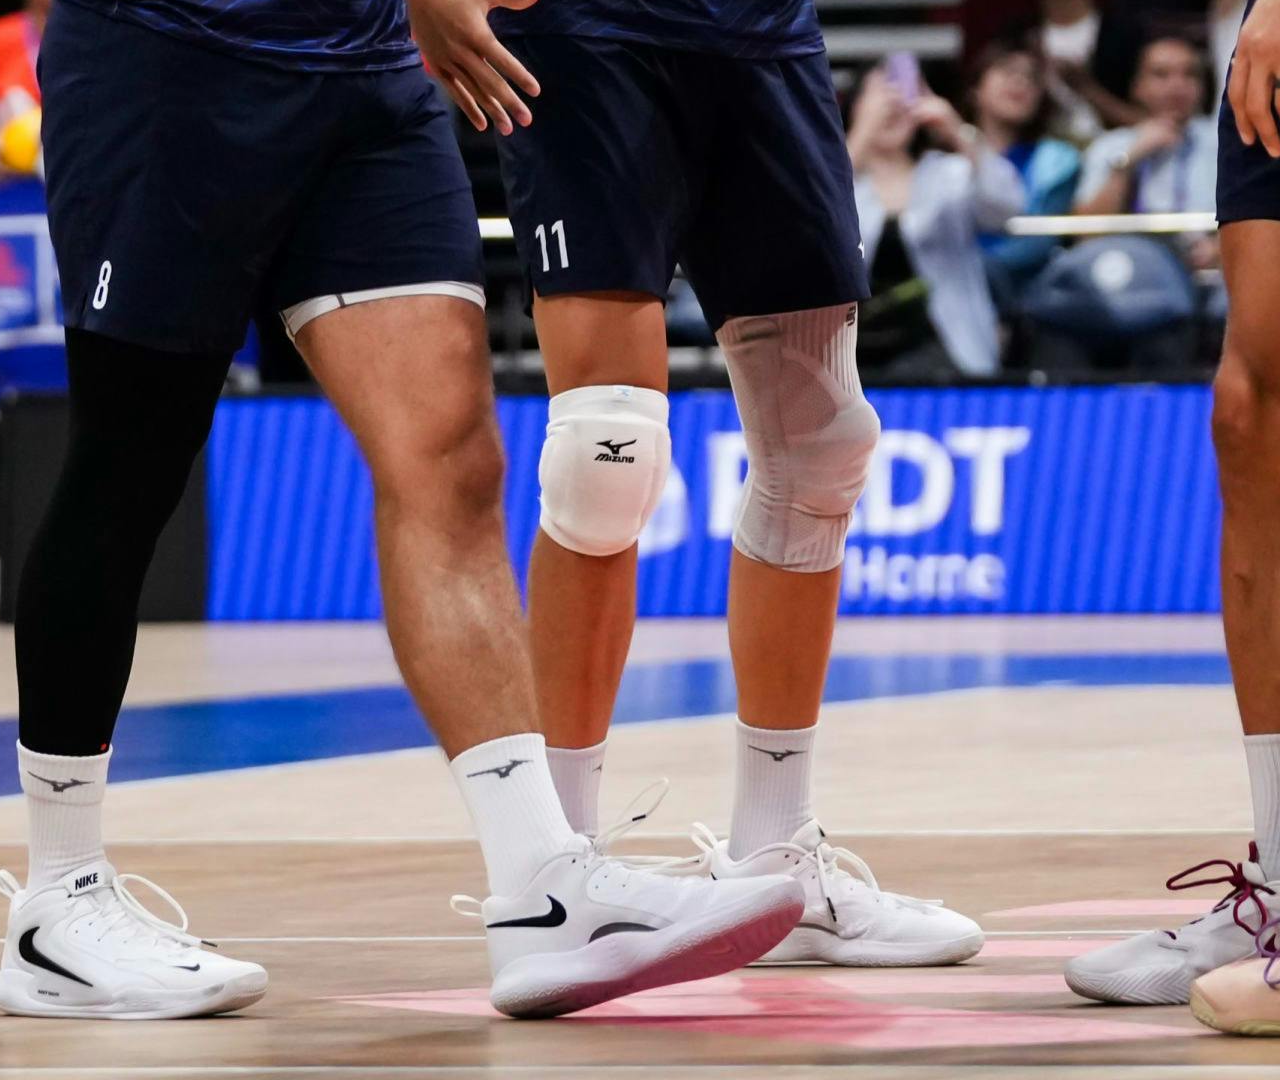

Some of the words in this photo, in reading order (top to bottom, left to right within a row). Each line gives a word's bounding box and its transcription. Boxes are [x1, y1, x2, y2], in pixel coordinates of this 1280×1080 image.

[535, 219, 569, 272] 11
[92, 260, 112, 310] 8
[844, 544, 1006, 602] Home
[75, 872, 99, 891] NIKE
